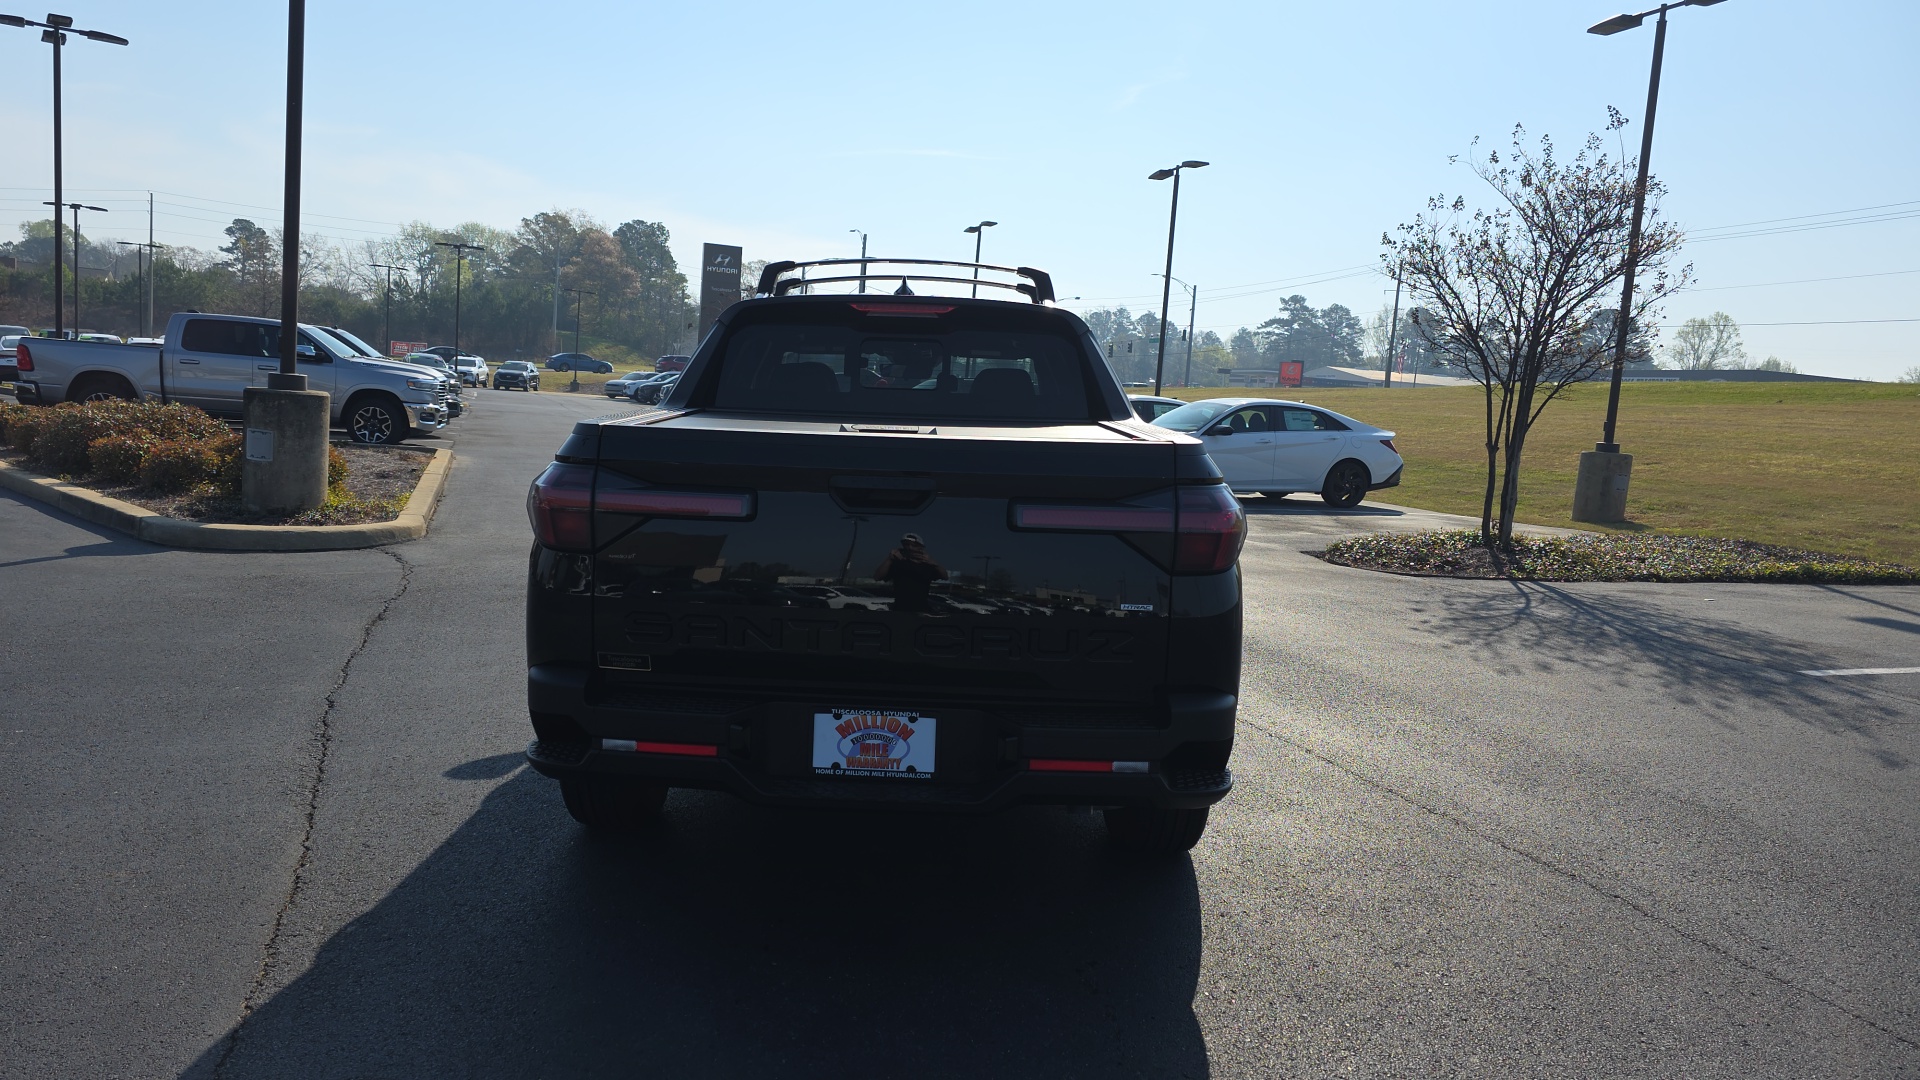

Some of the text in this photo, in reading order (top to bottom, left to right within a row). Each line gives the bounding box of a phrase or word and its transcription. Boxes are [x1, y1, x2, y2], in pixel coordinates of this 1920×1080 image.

[706, 266, 738, 275] HYUNDAI
[625, 611, 1134, 664] SANTA CRUZ
[831, 708, 920, 718] TUSCALOOSA HYUNDAI
[835, 715, 916, 741] MILLION
[859, 742, 889, 757] MILE
[845, 756, 902, 770] WARRANTY
[845, 769, 870, 777] MILLION
[871, 770, 885, 778] MILE
[886, 771, 931, 779] HYUNDAI.COM
